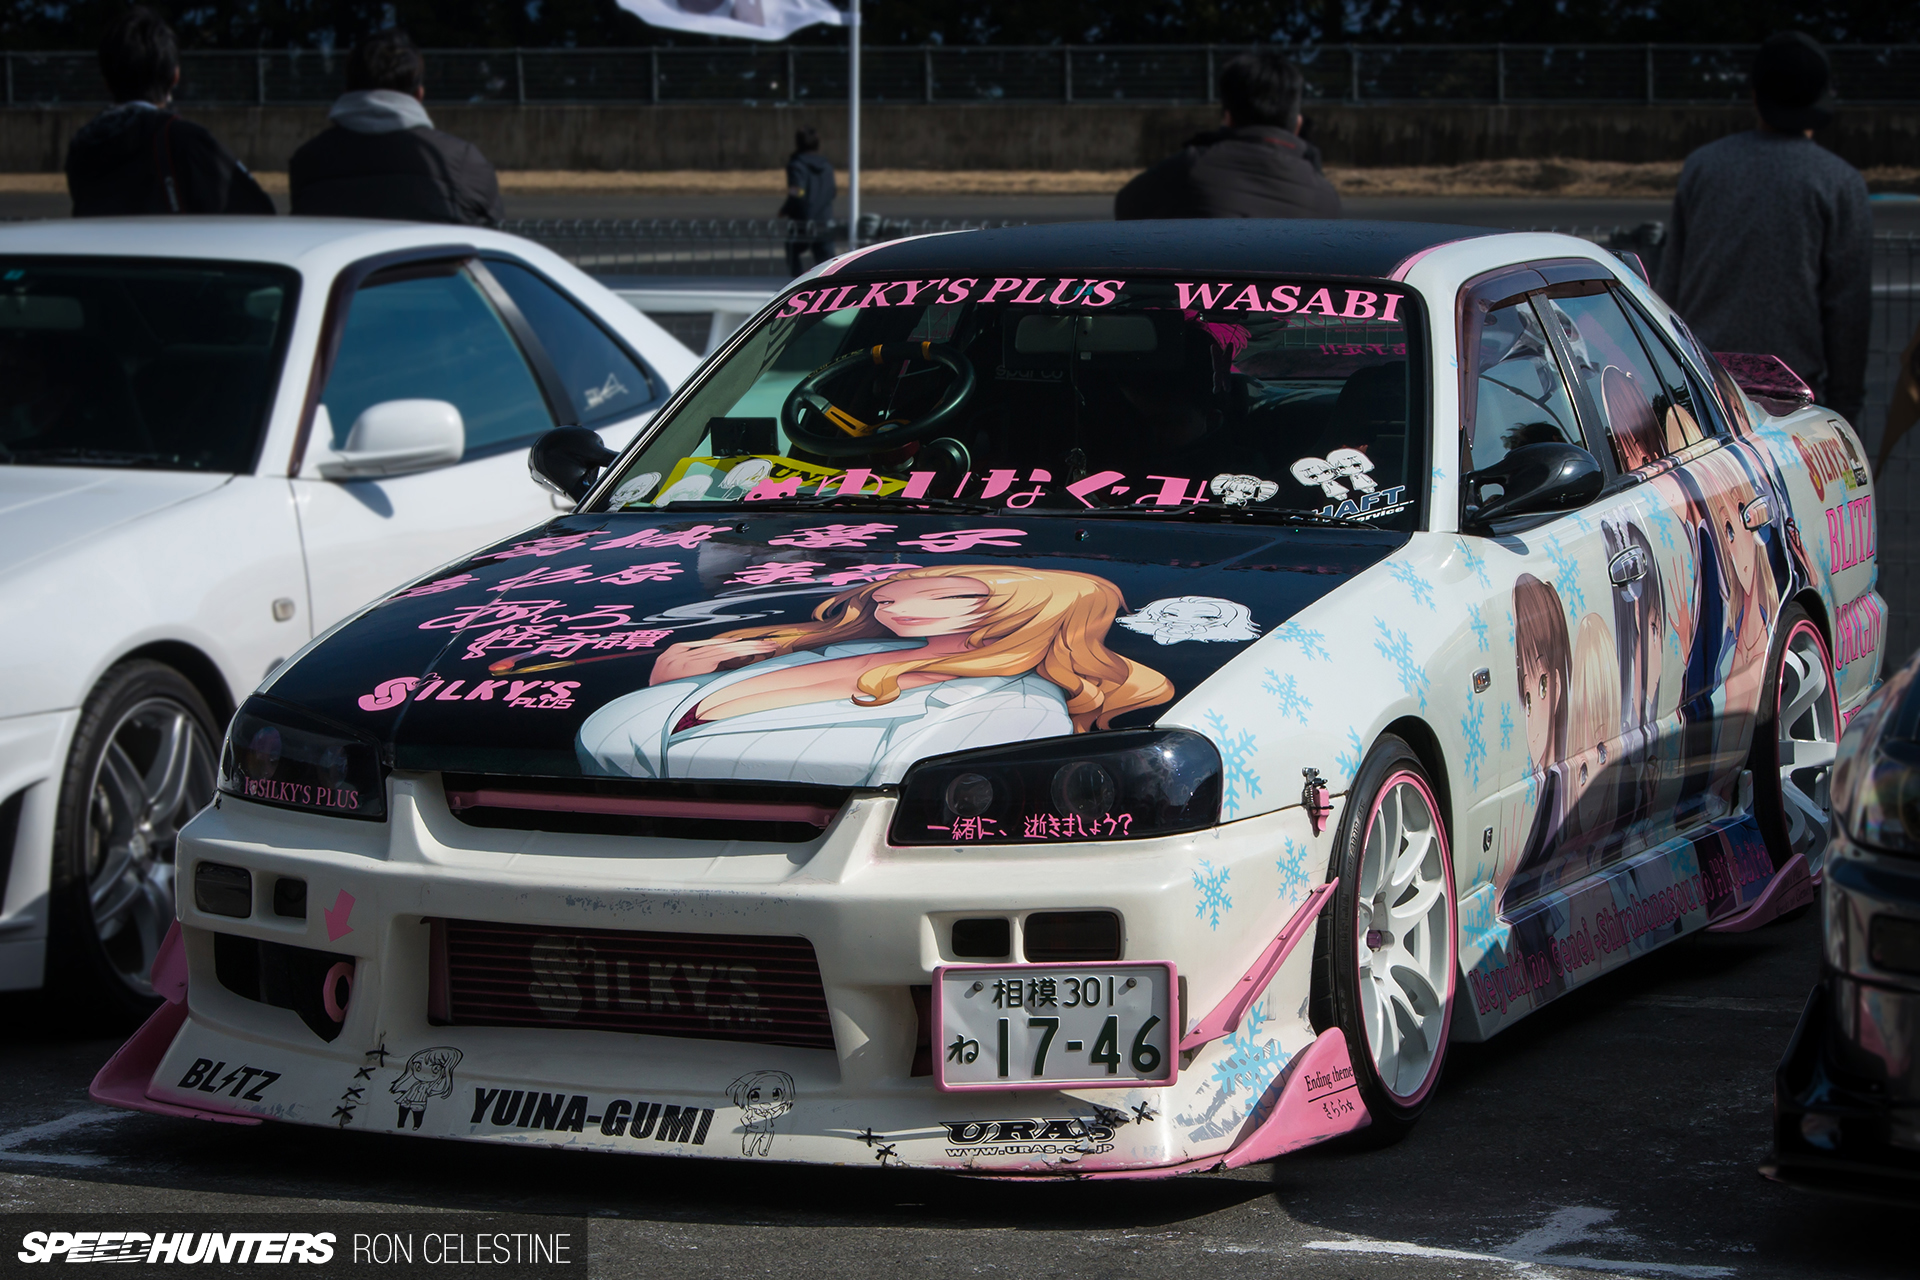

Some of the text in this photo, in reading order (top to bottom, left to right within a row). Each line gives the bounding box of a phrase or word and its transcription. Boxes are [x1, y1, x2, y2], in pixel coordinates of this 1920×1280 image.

[776, 278, 1404, 322] SILKY'S PLUS WASABI
[1300, 485, 1405, 521] HAFT
[1353, 506, 1404, 521] ervice
[1826, 495, 1875, 575] BLITZ
[1836, 592, 1881, 670] ORIGIN
[358, 675, 581, 712] SILKY'S
[509, 695, 573, 710] PLUS
[316, 787, 359, 810] PLUS
[992, 976, 1116, 1010] 相模 301
[947, 1014, 1162, 1078] ね 17-46
[1304, 1065, 1354, 1092] Ending theme
[470, 1087, 715, 1146] YUINA-GUMI
